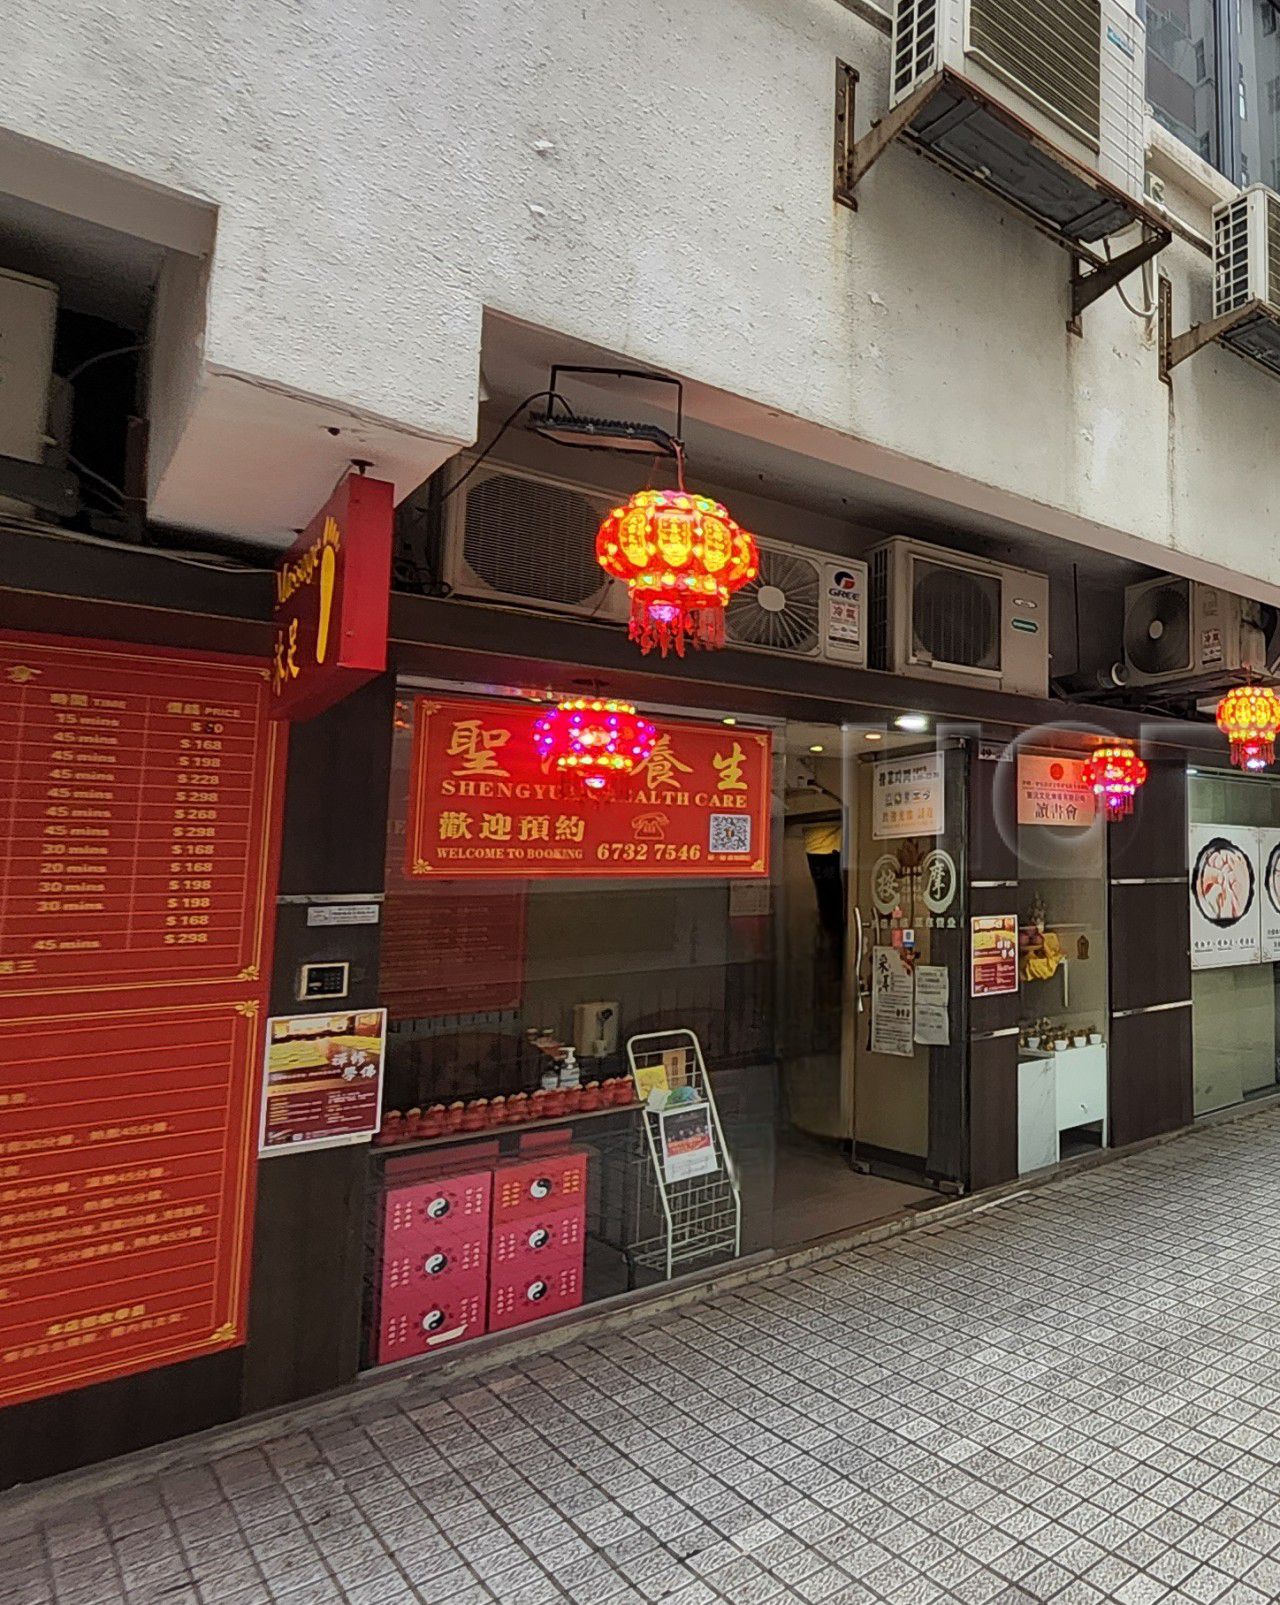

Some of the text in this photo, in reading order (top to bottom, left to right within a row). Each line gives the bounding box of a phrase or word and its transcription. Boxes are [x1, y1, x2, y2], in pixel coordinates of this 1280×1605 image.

[828, 587, 861, 601] GREE
[204, 706, 241, 718] PRICE
[55, 713, 78, 724] 15
[80, 716, 120, 727] mins
[53, 732, 75, 742] 45
[78, 733, 118, 745] mins
[51, 750, 74, 761] 45
[76, 751, 117, 763] mins
[446, 719, 748, 791] 聖養生
[50, 769, 72, 779] 45
[75, 770, 115, 781] mins
[48, 788, 71, 798] 45
[74, 789, 113, 800] mins
[695, 793, 747, 808] CARE
[46, 806, 69, 816] 45
[71, 807, 112, 818] mins
[44, 825, 66, 835] 45
[70, 826, 110, 836] mins
[438, 811, 586, 842] 歡迎預約
[42, 844, 66, 854] 30
[68, 844, 108, 854] mins
[437, 847, 583, 860] WELCOME TO BOOKING
[597, 843, 701, 861] 6732 7546
[40, 863, 64, 873] 20
[66, 863, 107, 873] mins
[929, 860, 946, 899] 摩
[39, 882, 62, 892] 30
[64, 881, 105, 892] mins
[37, 901, 61, 912] 30
[63, 901, 103, 911] mins
[34, 940, 57, 950] 45
[60, 939, 100, 949] mins
